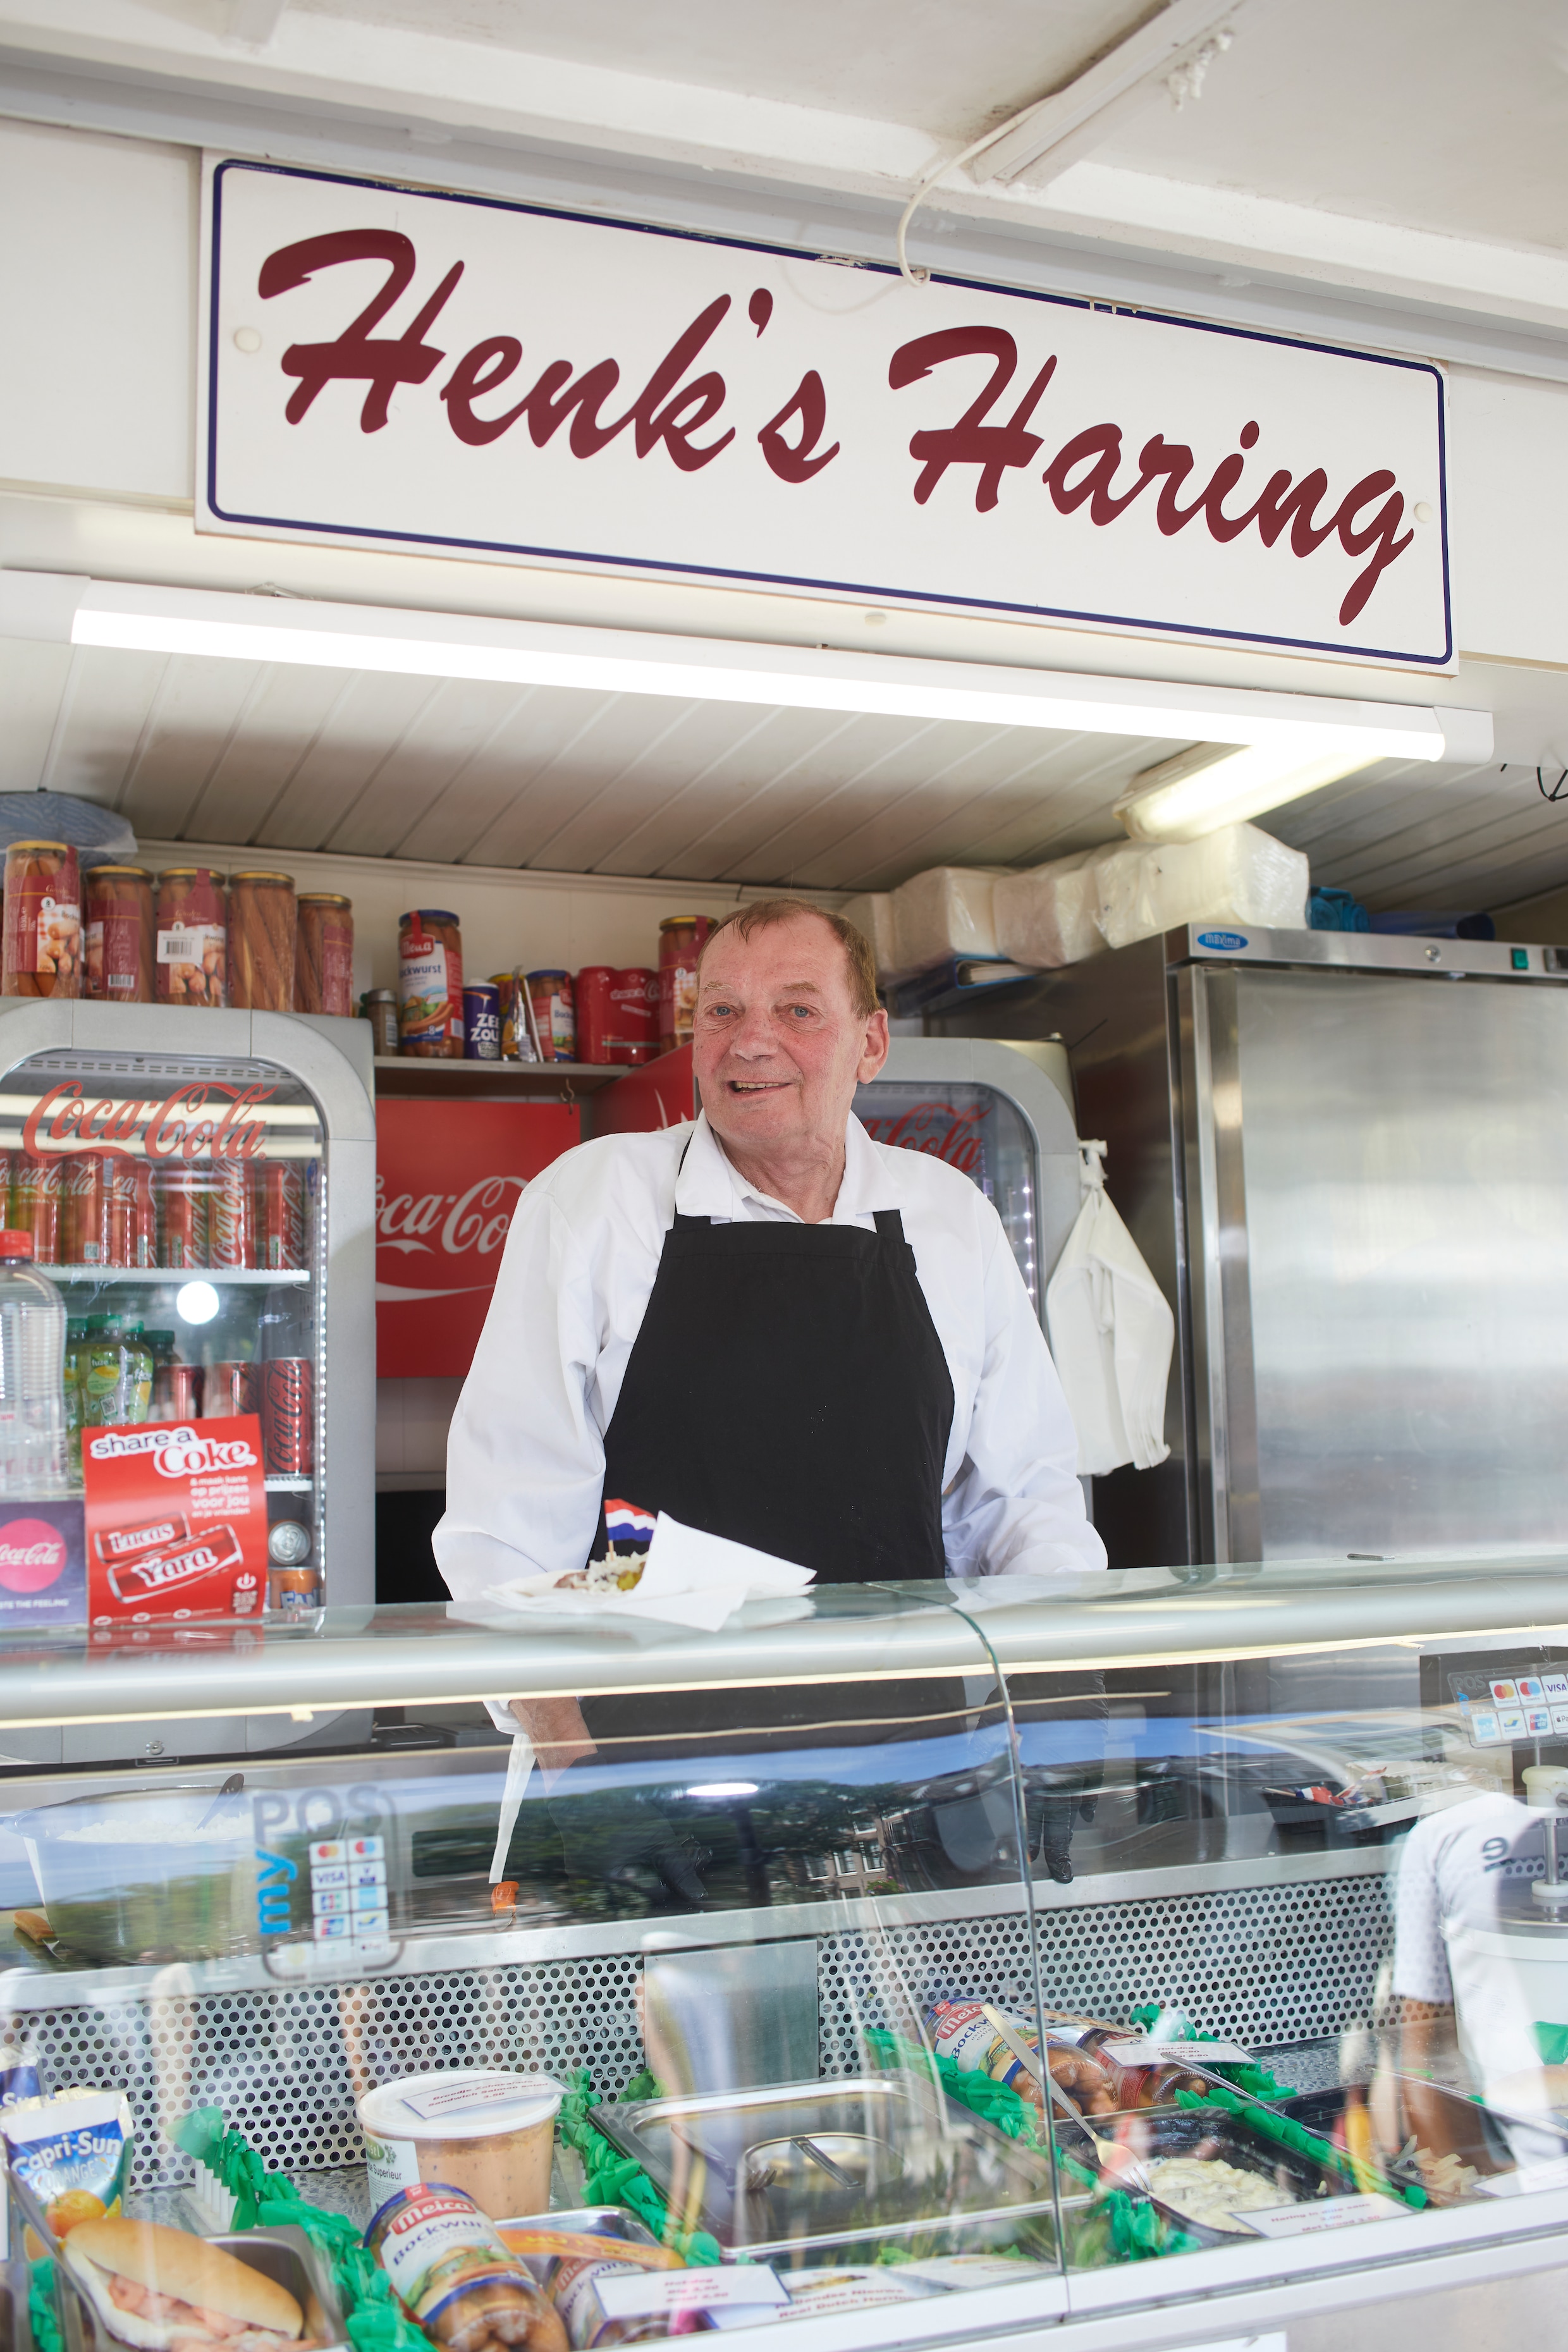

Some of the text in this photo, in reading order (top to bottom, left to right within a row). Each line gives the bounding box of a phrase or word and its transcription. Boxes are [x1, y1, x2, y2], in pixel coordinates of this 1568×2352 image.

[258, 228, 1414, 626] Henk's Haring
[470, 1027, 499, 1043] ZOU
[23, 1081, 279, 1160] Coca-Cola
[376, 1174, 530, 1254] oca-Co
[95, 1430, 192, 1455] share a
[159, 1442, 246, 1473] Coke
[191, 1487, 207, 1497] op
[192, 1494, 249, 1509] voor jou
[110, 1524, 174, 1552] Lucas
[133, 1548, 216, 1586] Yara
[16, 1600, 32, 1608] THE
[33, 1598, 69, 1608] FEELING
[279, 1588, 320, 1610] FAN
[1547, 1683, 1567, 1693] VISA
[253, 1785, 383, 1845] POS
[316, 1870, 345, 1884] VISA
[255, 1848, 298, 1935] my
[941, 2006, 983, 2035] Meic
[951, 2018, 990, 2060] Bockw
[971, 2027, 987, 2041] extra
[976, 2028, 992, 2042] extra
[428, 2092, 478, 2107] Sandwich
[481, 2086, 518, 2094] Salmon
[432, 2088, 472, 2100] Broodje
[10, 2131, 122, 2181] Capri-Sun
[373, 2164, 402, 2181] Superieur
[397, 2200, 473, 2231] Meica
